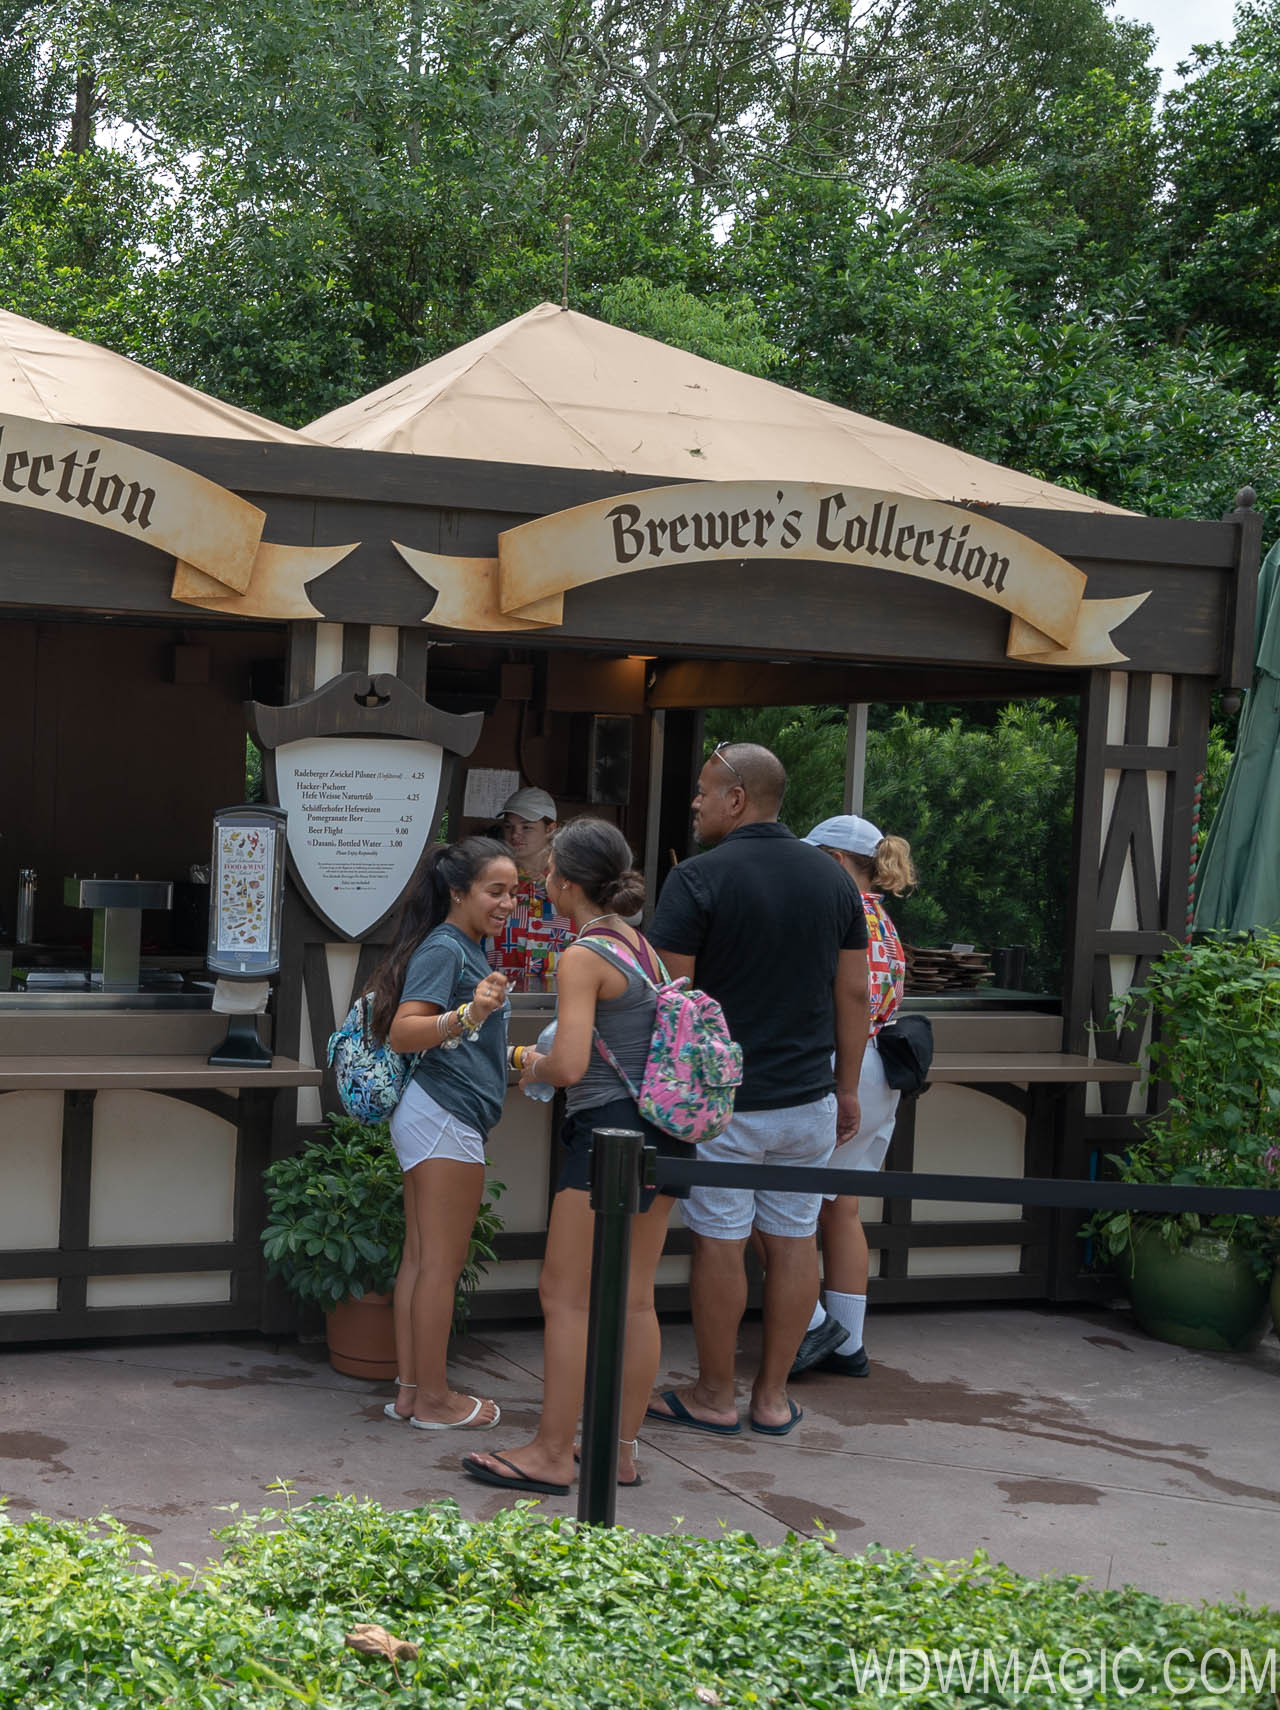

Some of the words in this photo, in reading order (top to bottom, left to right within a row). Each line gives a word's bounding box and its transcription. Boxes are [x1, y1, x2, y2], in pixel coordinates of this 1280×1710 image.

[604, 490, 802, 564] Brewer's
[816, 491, 1011, 594] Collection
[294, 769, 329, 780] Radeberger
[329, 769, 354, 778] Zwickel
[355, 770, 376, 779] Pilsner
[411, 772, 425, 780] 4.25
[296, 781, 346, 791] Hacker-Pschorr
[302, 791, 318, 800] Hefe
[319, 792, 341, 800] Weisse
[407, 793, 420, 801] 4.25
[345, 804, 381, 813] Hefeweizen
[307, 814, 348, 823] Pomegranate
[349, 814, 364, 822] Beer
[399, 815, 413, 823] 4.25
[308, 826, 323, 834] Beer
[324, 826, 343, 836] Flight
[395, 827, 409, 835] 9.00
[338, 840, 361, 848] Bottled
[362, 840, 382, 848] Water
[390, 840, 403, 848] 3.00
